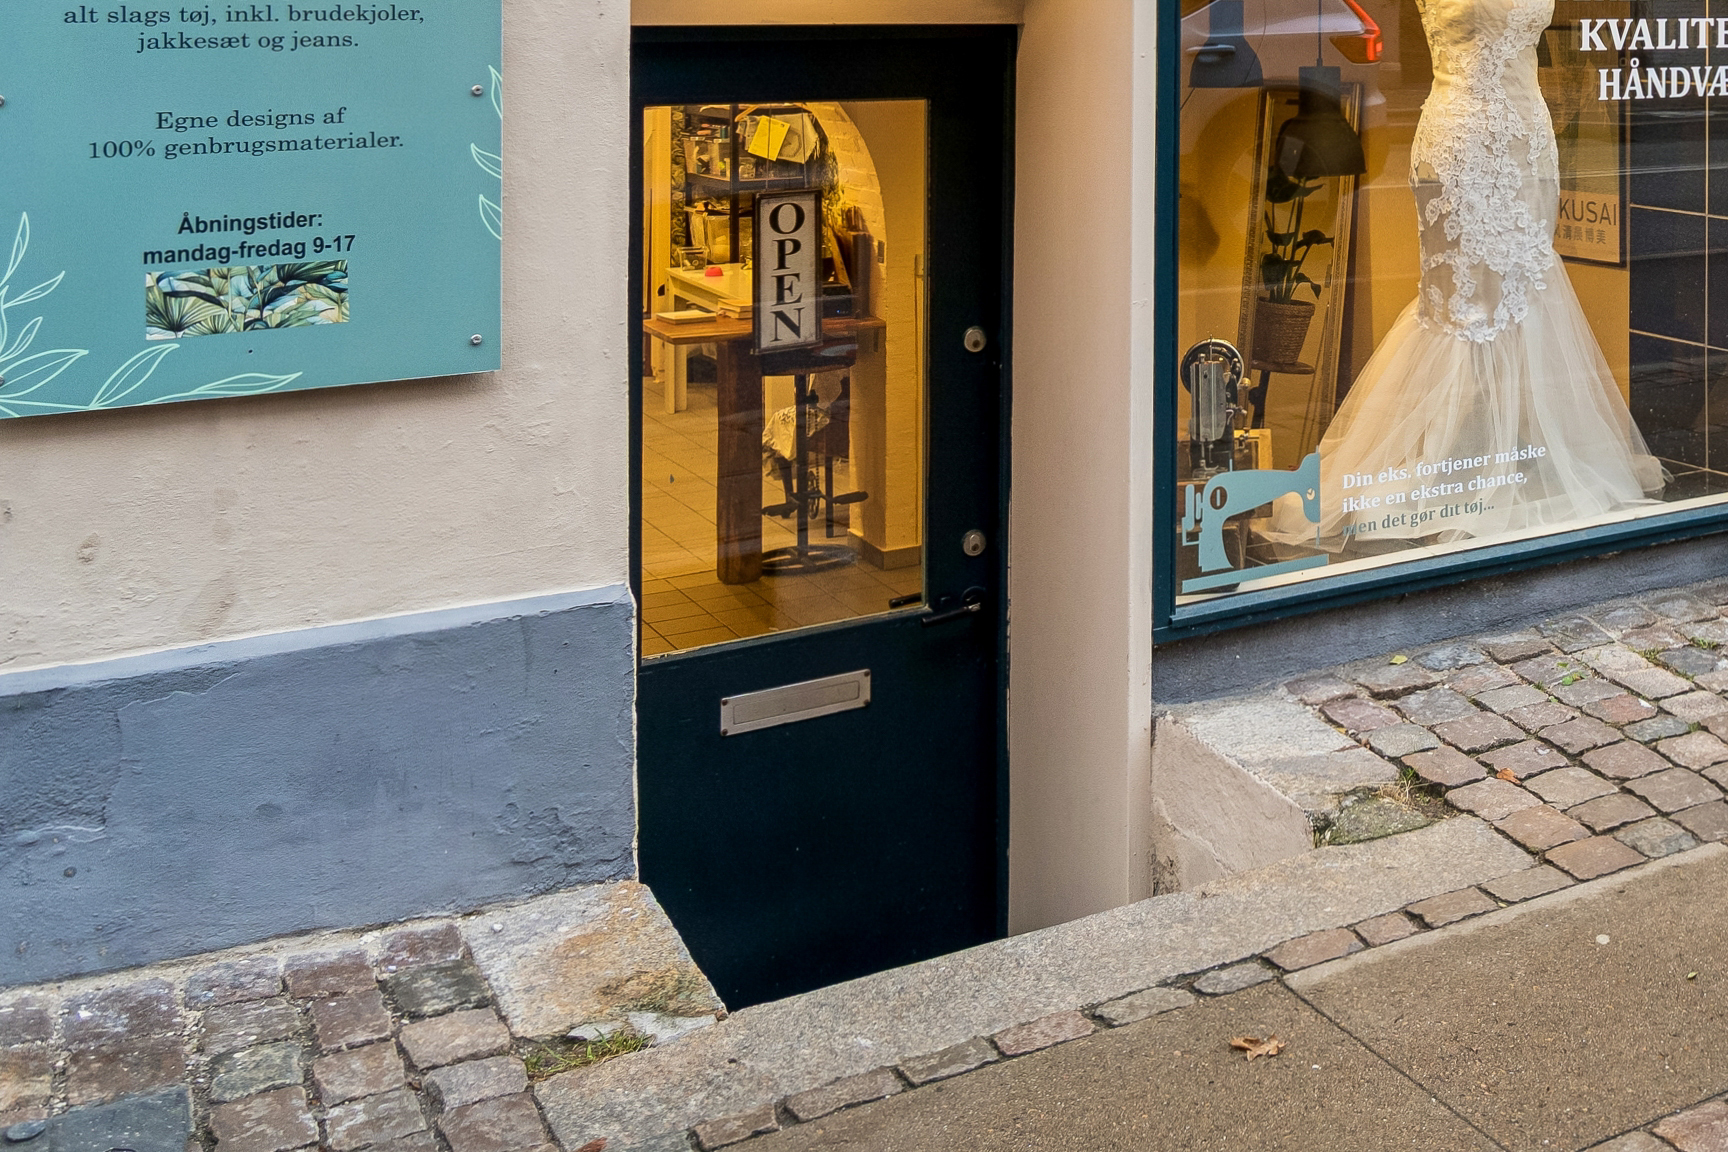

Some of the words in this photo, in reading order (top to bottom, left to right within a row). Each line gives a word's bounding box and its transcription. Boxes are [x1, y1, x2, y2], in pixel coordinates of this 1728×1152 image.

[64, 5, 99, 24] alt
[107, 5, 171, 26] slags
[179, 5, 216, 26] tøj,
[226, 4, 280, 23] inkl.
[288, 3, 425, 25] brudekjoler,
[137, 31, 250, 53] jakkesæt
[258, 35, 284, 51] og
[290, 31, 359, 51] jeans.
[156, 111, 218, 132] Egne
[226, 109, 315, 129] designs
[323, 107, 347, 125] af
[88, 138, 156, 159] 100%
[164, 132, 404, 158] genbrugsmaterialer.
[177, 210, 324, 235] Åbningstider:
[1559, 198, 1617, 226] KUSAI
[143, 238, 306, 265] mandag-fredag
[313, 235, 356, 253] 9-17
[768, 202, 807, 342] OPEN
[1342, 471, 1373, 489] Din
[1378, 466, 1412, 483] eks.
[1416, 453, 1491, 477] fortjener
[1495, 444, 1546, 464] måske
[1342, 495, 1381, 513] ikke
[1385, 490, 1406, 505] en
[1411, 481, 1464, 501] ekstra
[1467, 471, 1528, 492] chance,
[1342, 519, 1377, 536] men
[1382, 513, 1407, 529] det
[1410, 508, 1436, 528] gør
